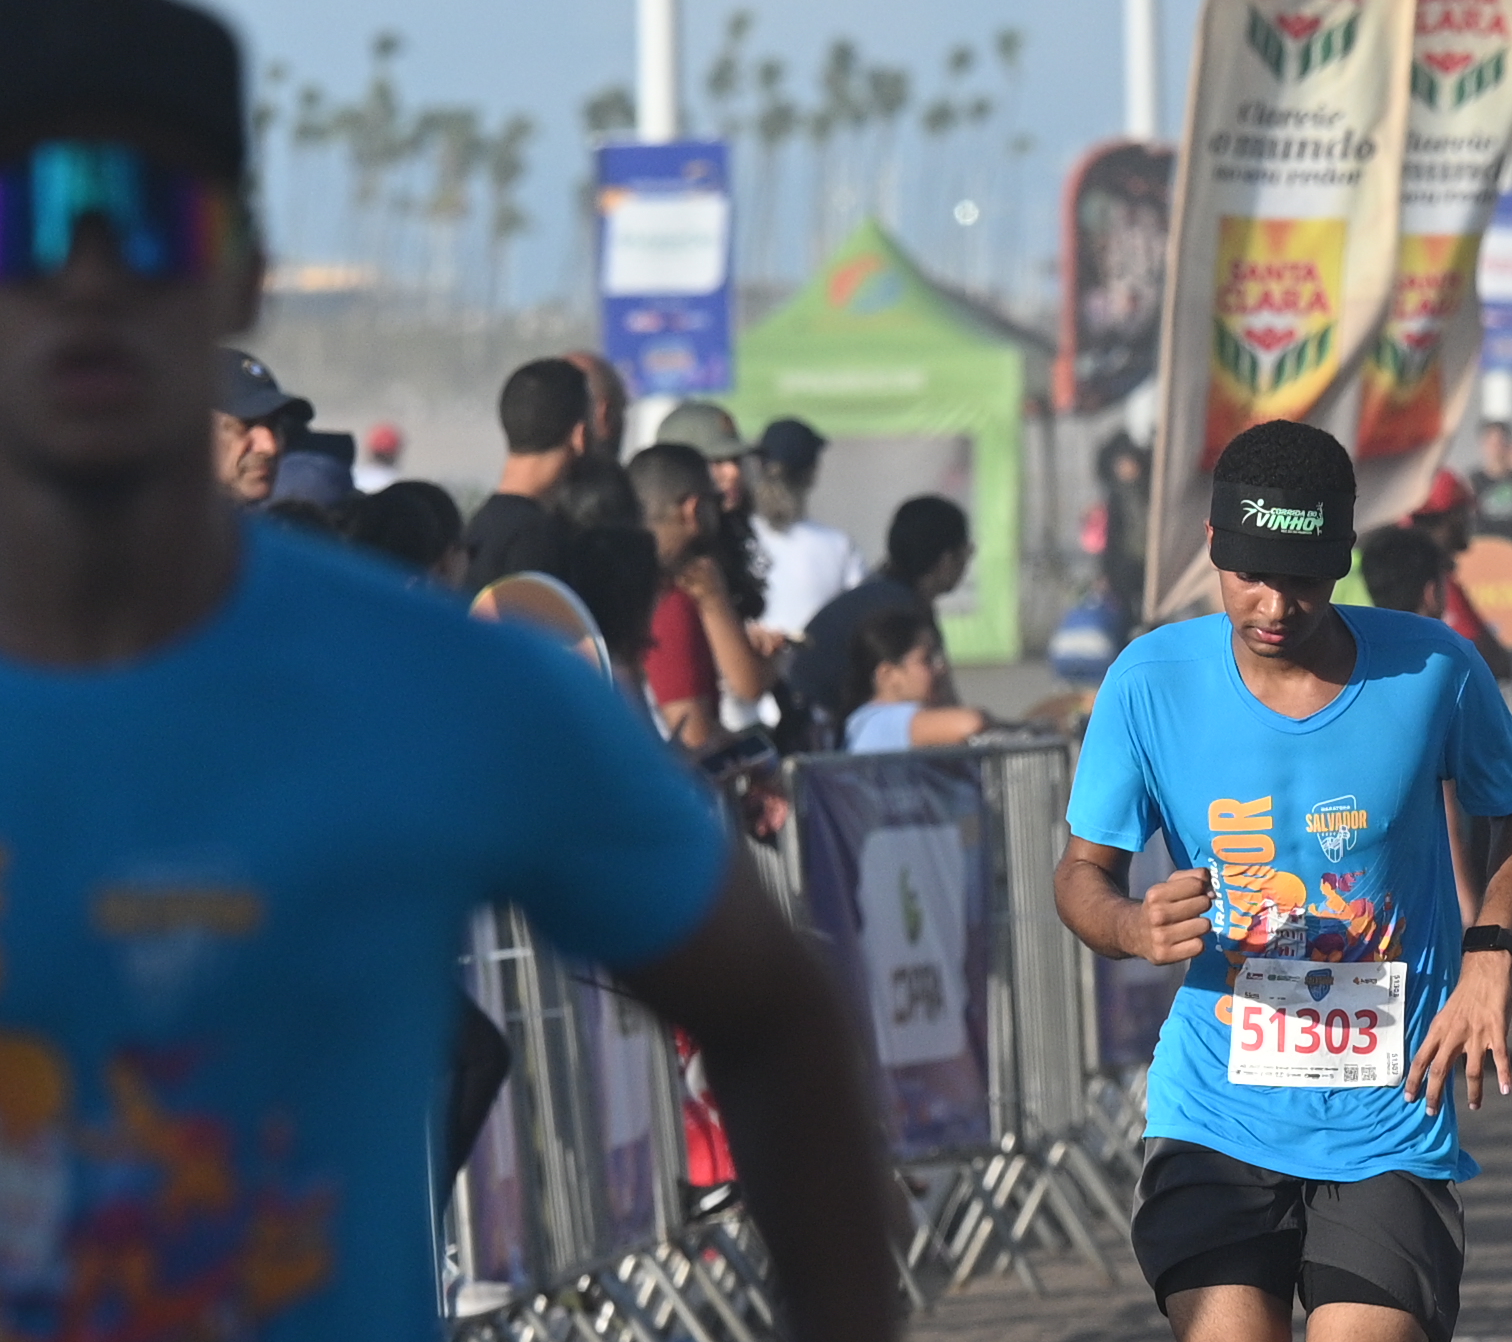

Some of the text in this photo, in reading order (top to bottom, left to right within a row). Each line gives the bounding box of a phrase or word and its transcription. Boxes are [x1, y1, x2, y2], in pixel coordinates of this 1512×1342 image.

[1256, 512, 1316, 531] VINHO
[1305, 810, 1367, 832] SALVADOR
[1241, 1006, 1378, 1055] 51303
